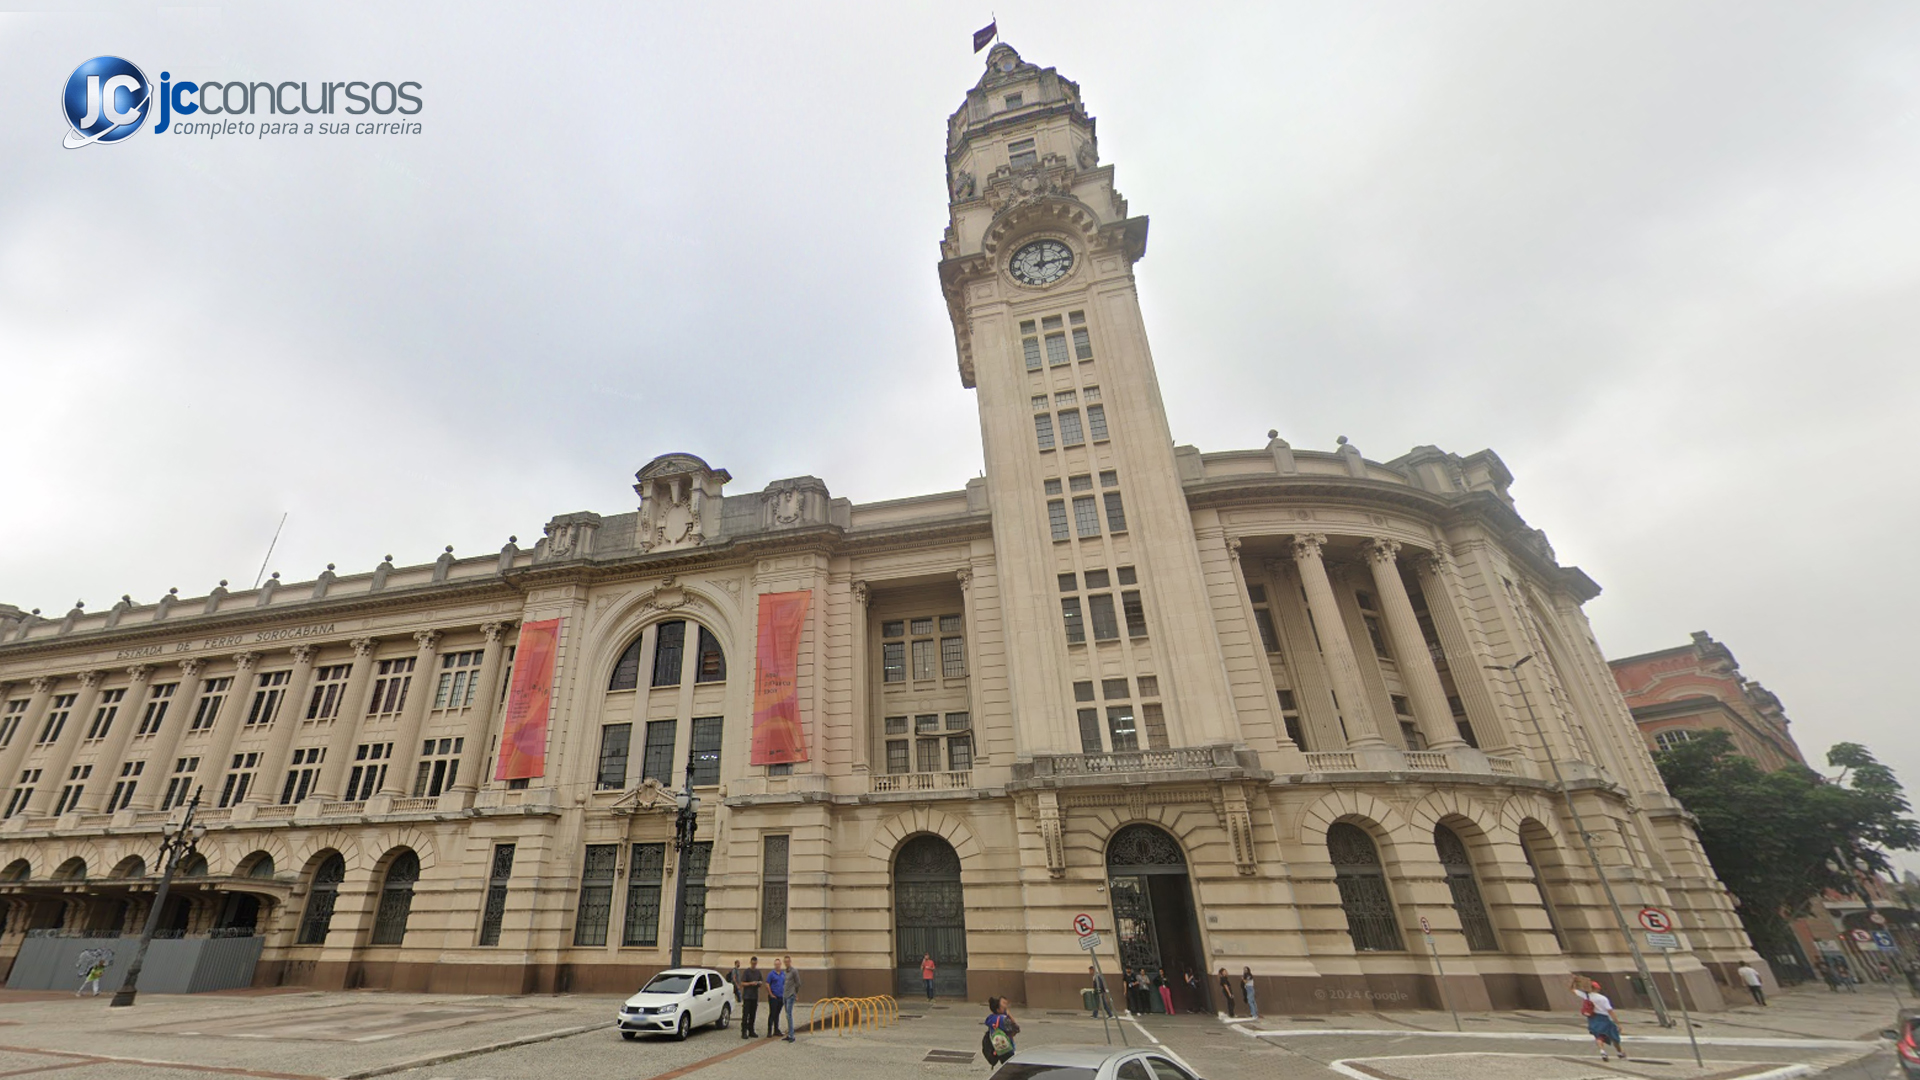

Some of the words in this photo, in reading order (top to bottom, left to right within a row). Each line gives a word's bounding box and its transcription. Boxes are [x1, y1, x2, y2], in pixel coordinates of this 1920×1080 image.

[116, 645, 163, 660] ESTRADA
[176, 641, 193, 652] DE
[203, 635, 242, 649] FERRO
[255, 623, 336, 642] SOROCABANA
